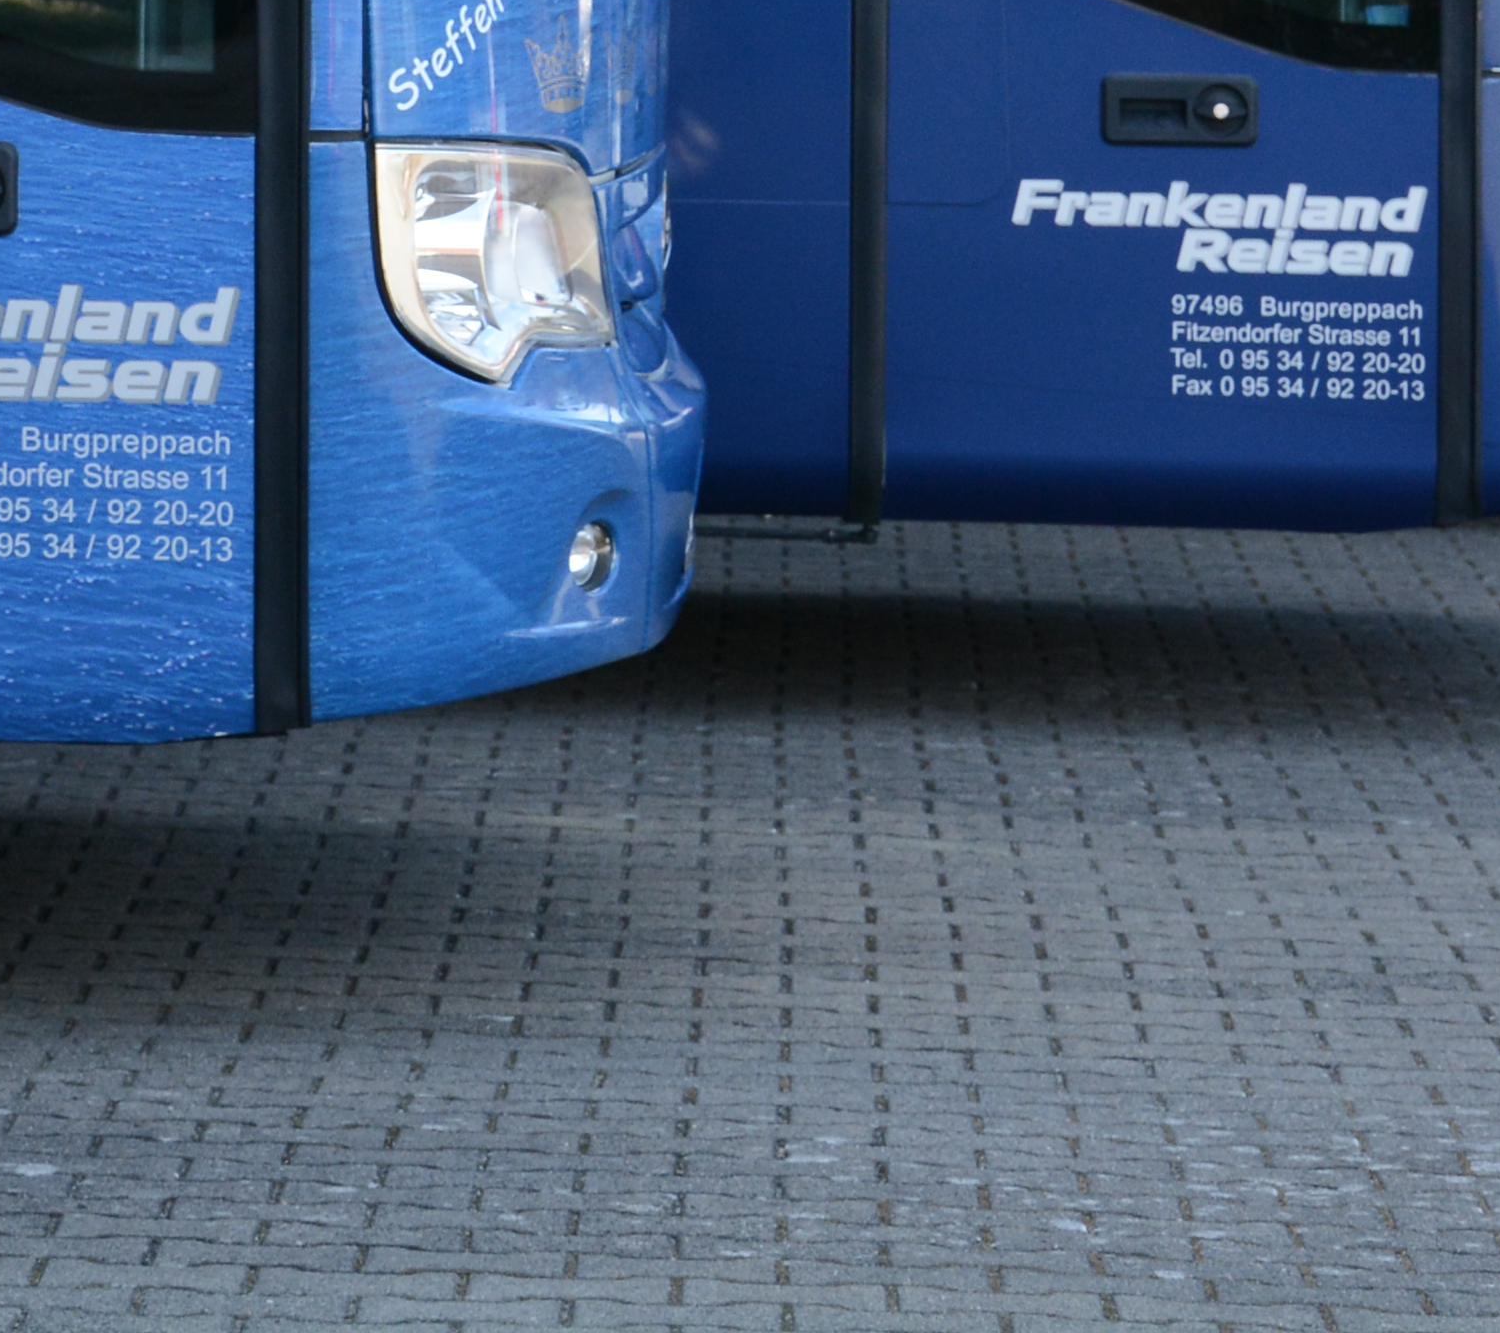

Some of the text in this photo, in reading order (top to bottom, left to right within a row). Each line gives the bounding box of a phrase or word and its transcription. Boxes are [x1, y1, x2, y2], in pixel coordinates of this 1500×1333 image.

[1011, 178, 1428, 232] Frankenland
[1175, 228, 1414, 277] Reisen
[1171, 294, 1423, 323] 97496 Burgpreppach
[1171, 320, 1421, 346] Fitzendorfer Strasse 11
[1170, 347, 1426, 374] Tel. 0 95 34 / 92 20-20
[1171, 374, 1425, 401] Fax 0 95 34 / 92 20-13
[21, 426, 231, 460] Burgpreppach
[83, 463, 189, 490] Strasse
[201, 465, 227, 491] 11
[42, 498, 77, 524] 34
[86, 498, 98, 524] /
[107, 499, 141, 525] 92
[153, 500, 234, 527] 20-20
[42, 533, 77, 559] 34
[85, 534, 96, 559] /
[107, 534, 141, 560] 92
[153, 536, 233, 562] 20-13
